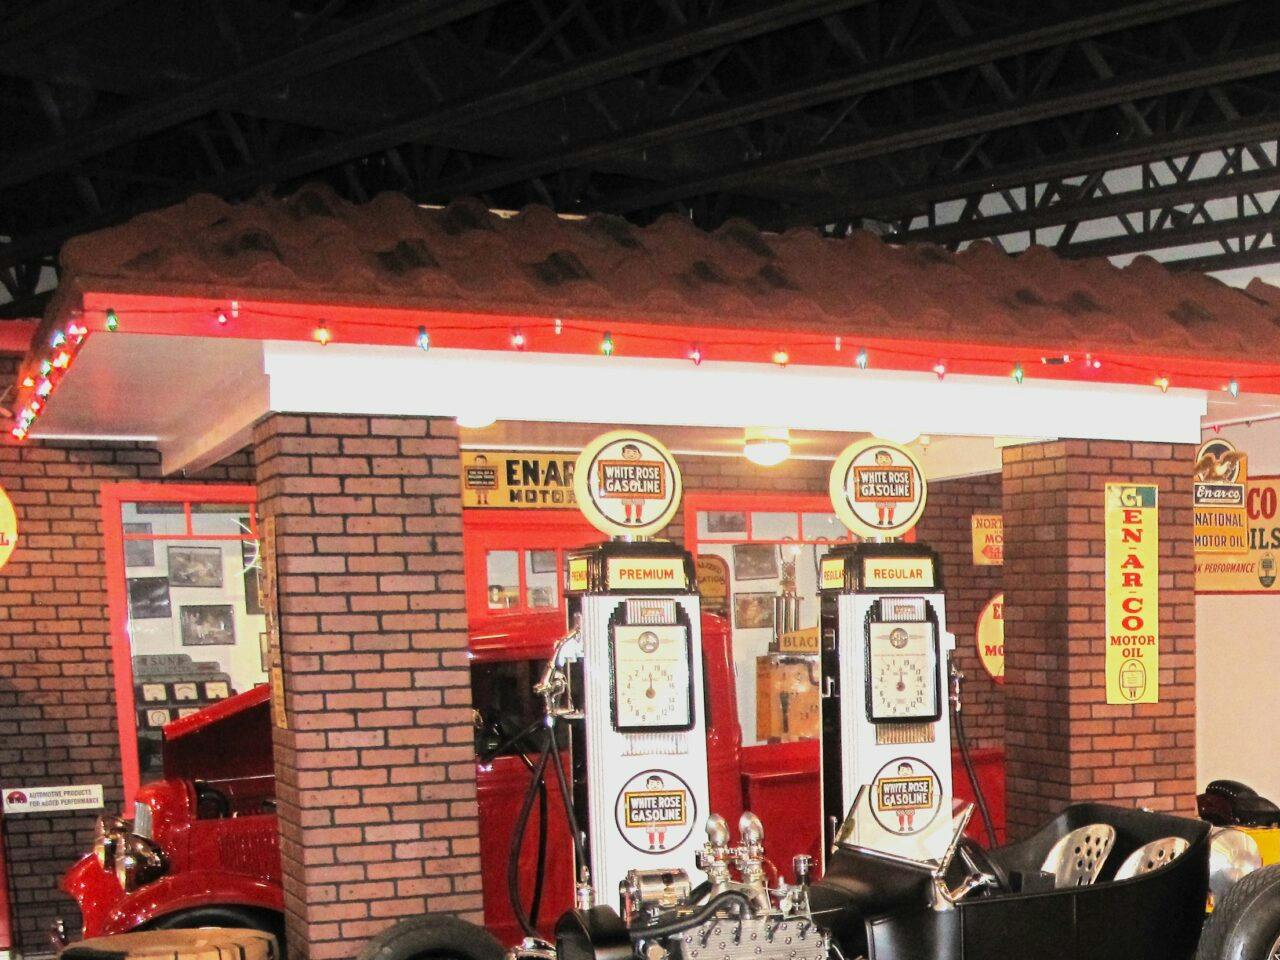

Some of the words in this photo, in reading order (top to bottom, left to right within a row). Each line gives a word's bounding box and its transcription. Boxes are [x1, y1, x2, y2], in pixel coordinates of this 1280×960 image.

[605, 466, 635, 479] WHITE
[636, 466, 660, 480] ROSE
[860, 471, 887, 484] WHITE
[888, 472, 909, 484] ROSE
[606, 479, 660, 493] GASOLINE
[861, 484, 910, 497] GASOLINE
[1195, 512, 1243, 527] NATIONAL
[1195, 535, 1226, 548] MOTOR
[1229, 535, 1244, 548] OIL
[620, 568, 674, 580] PREMIUM
[874, 568, 923, 579] REGULAR
[1205, 563, 1256, 574] PERFORMANCE
[1110, 636, 1155, 646] MOTOR
[1122, 648, 1144, 658] OIL
[883, 782, 907, 793] WHITE
[907, 782, 928, 793] ROSE
[631, 797, 658, 809] WHITE
[658, 796, 681, 808] ROSE
[884, 793, 928, 806] GASOLINE
[631, 808, 681, 822] GASOLINE
